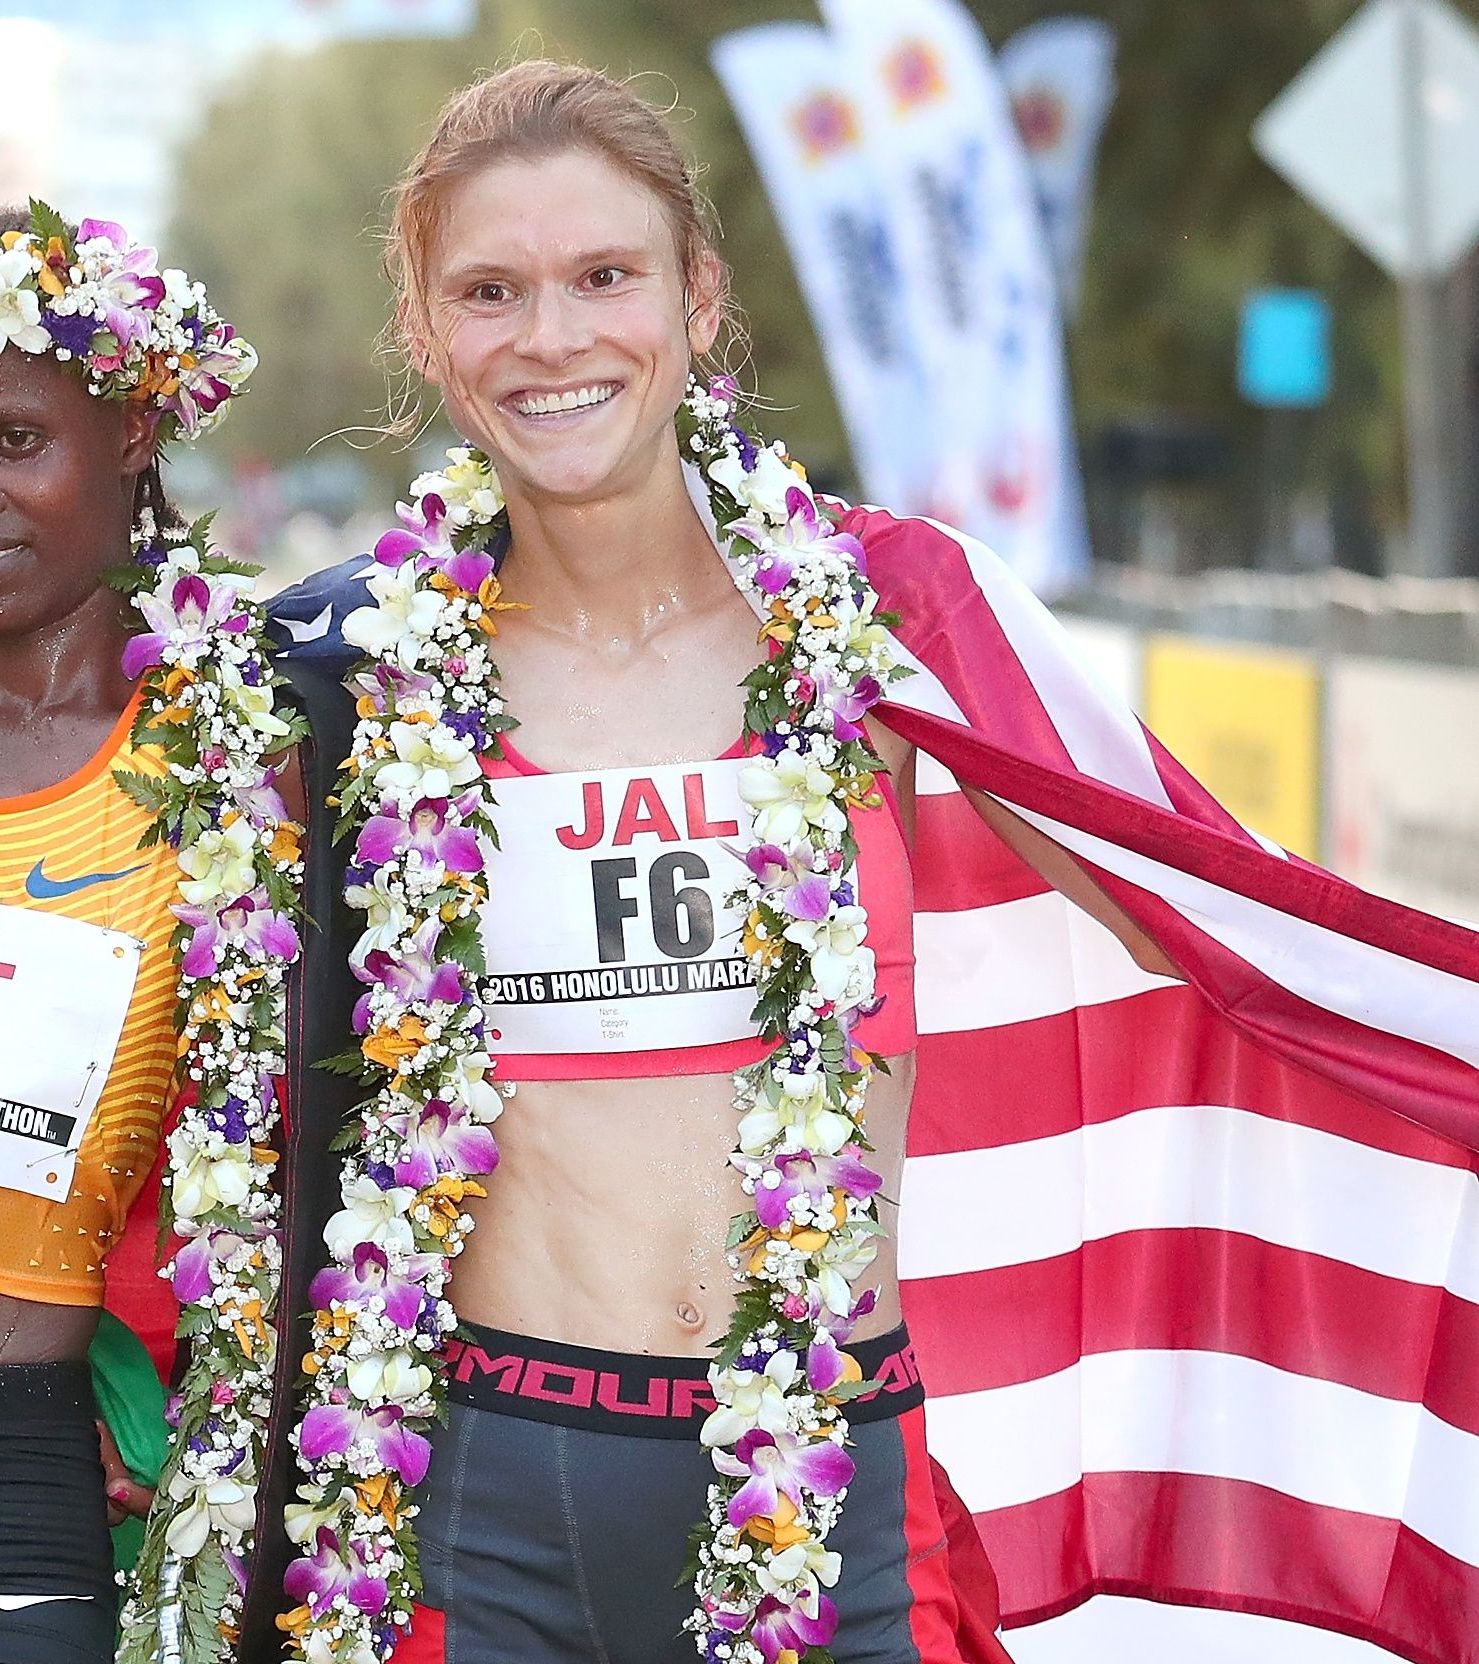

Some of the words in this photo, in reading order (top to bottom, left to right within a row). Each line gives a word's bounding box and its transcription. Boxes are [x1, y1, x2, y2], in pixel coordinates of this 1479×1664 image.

[555, 773, 739, 850] JAL
[591, 851, 715, 963] F6
[489, 975, 545, 1001] 2016
[550, 965, 680, 999] HONOLULU
